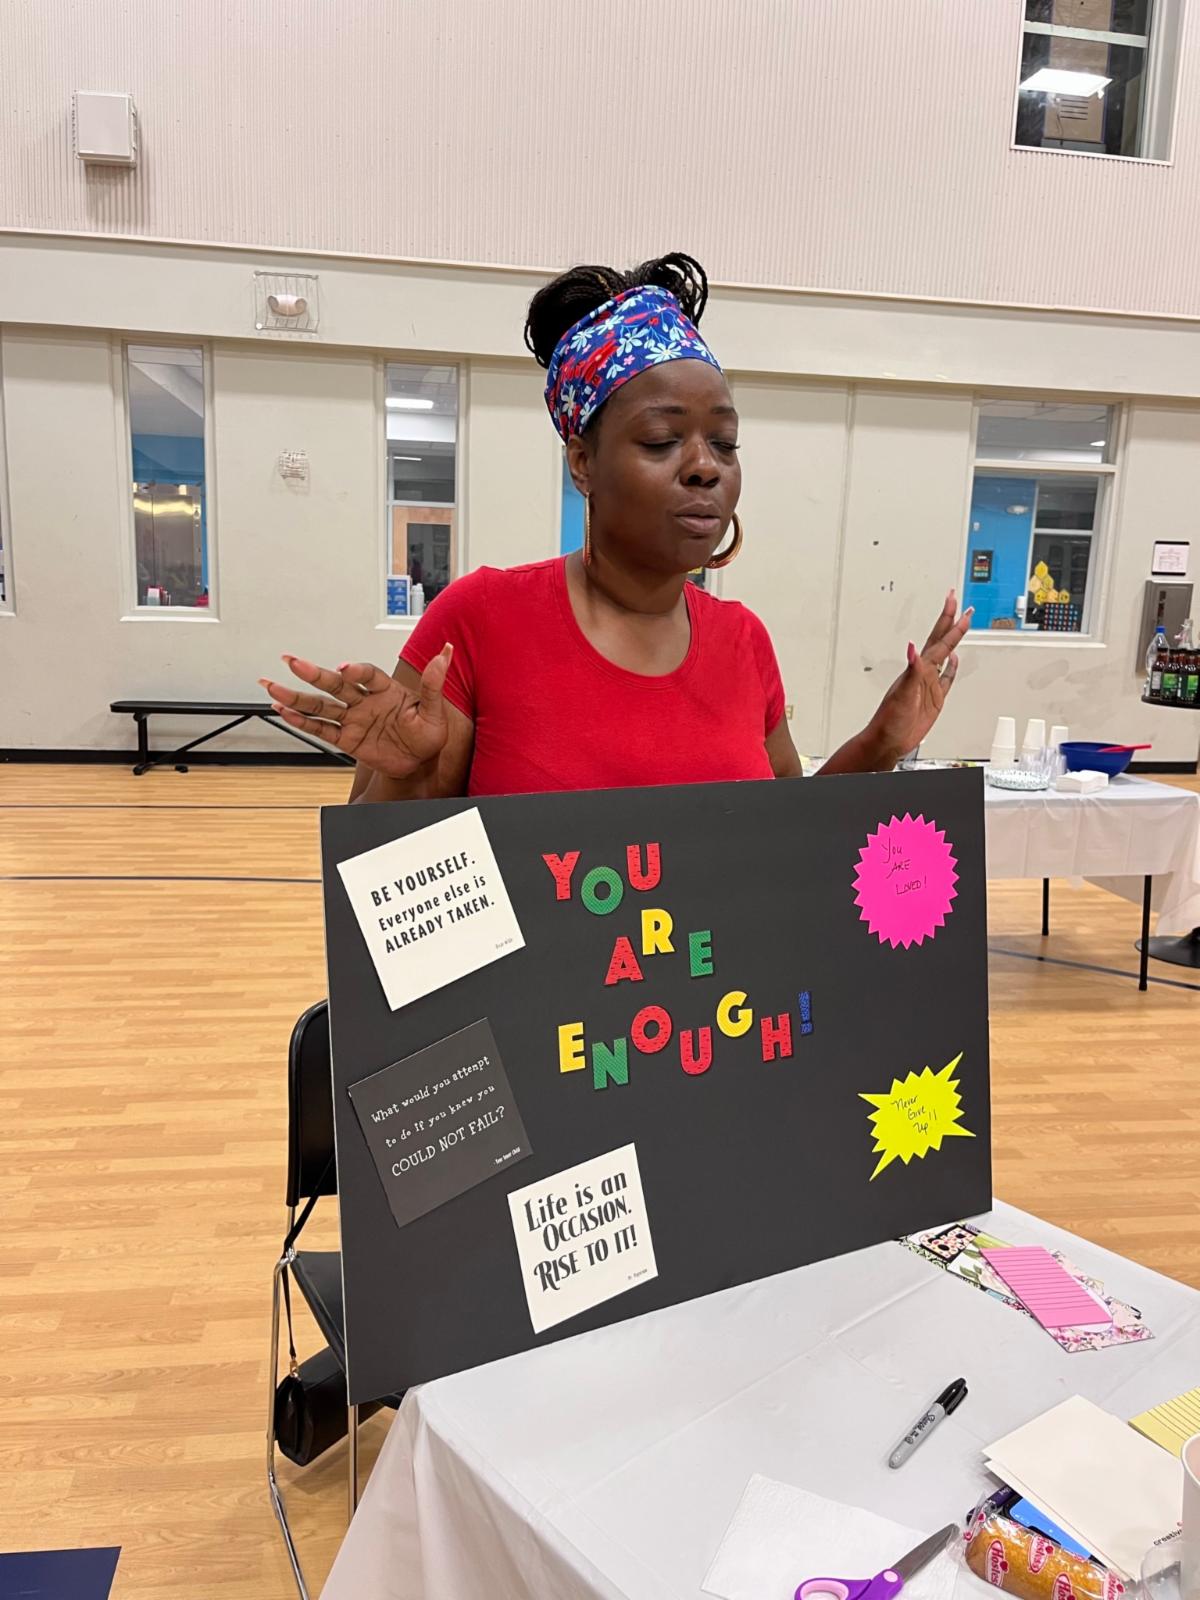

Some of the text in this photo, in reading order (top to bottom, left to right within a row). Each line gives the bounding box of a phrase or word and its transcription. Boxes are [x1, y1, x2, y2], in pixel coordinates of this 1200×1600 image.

[370, 851, 476, 907] BE YOURSELF.
[542, 842, 662, 915] YOU
[881, 837, 902, 863] You
[378, 875, 487, 931] Everyone else is
[385, 894, 495, 953] ALREADY TAKEN.
[603, 908, 714, 986] ARE
[558, 990, 813, 1090] ENOUGH!
[371, 1056, 490, 1124] What would you attempt
[385, 1085, 496, 1148] to do if you knew you
[891, 1095, 918, 1111] Never
[907, 1106, 926, 1120] Give
[391, 1105, 505, 1177] COULD NOT FAIL?
[523, 1172, 628, 1232] Life is an
[543, 1195, 632, 1252] OCCASION.
[533, 1224, 638, 1293] RISE TO IT!
[1153, 1528, 1182, 1546] creativ
